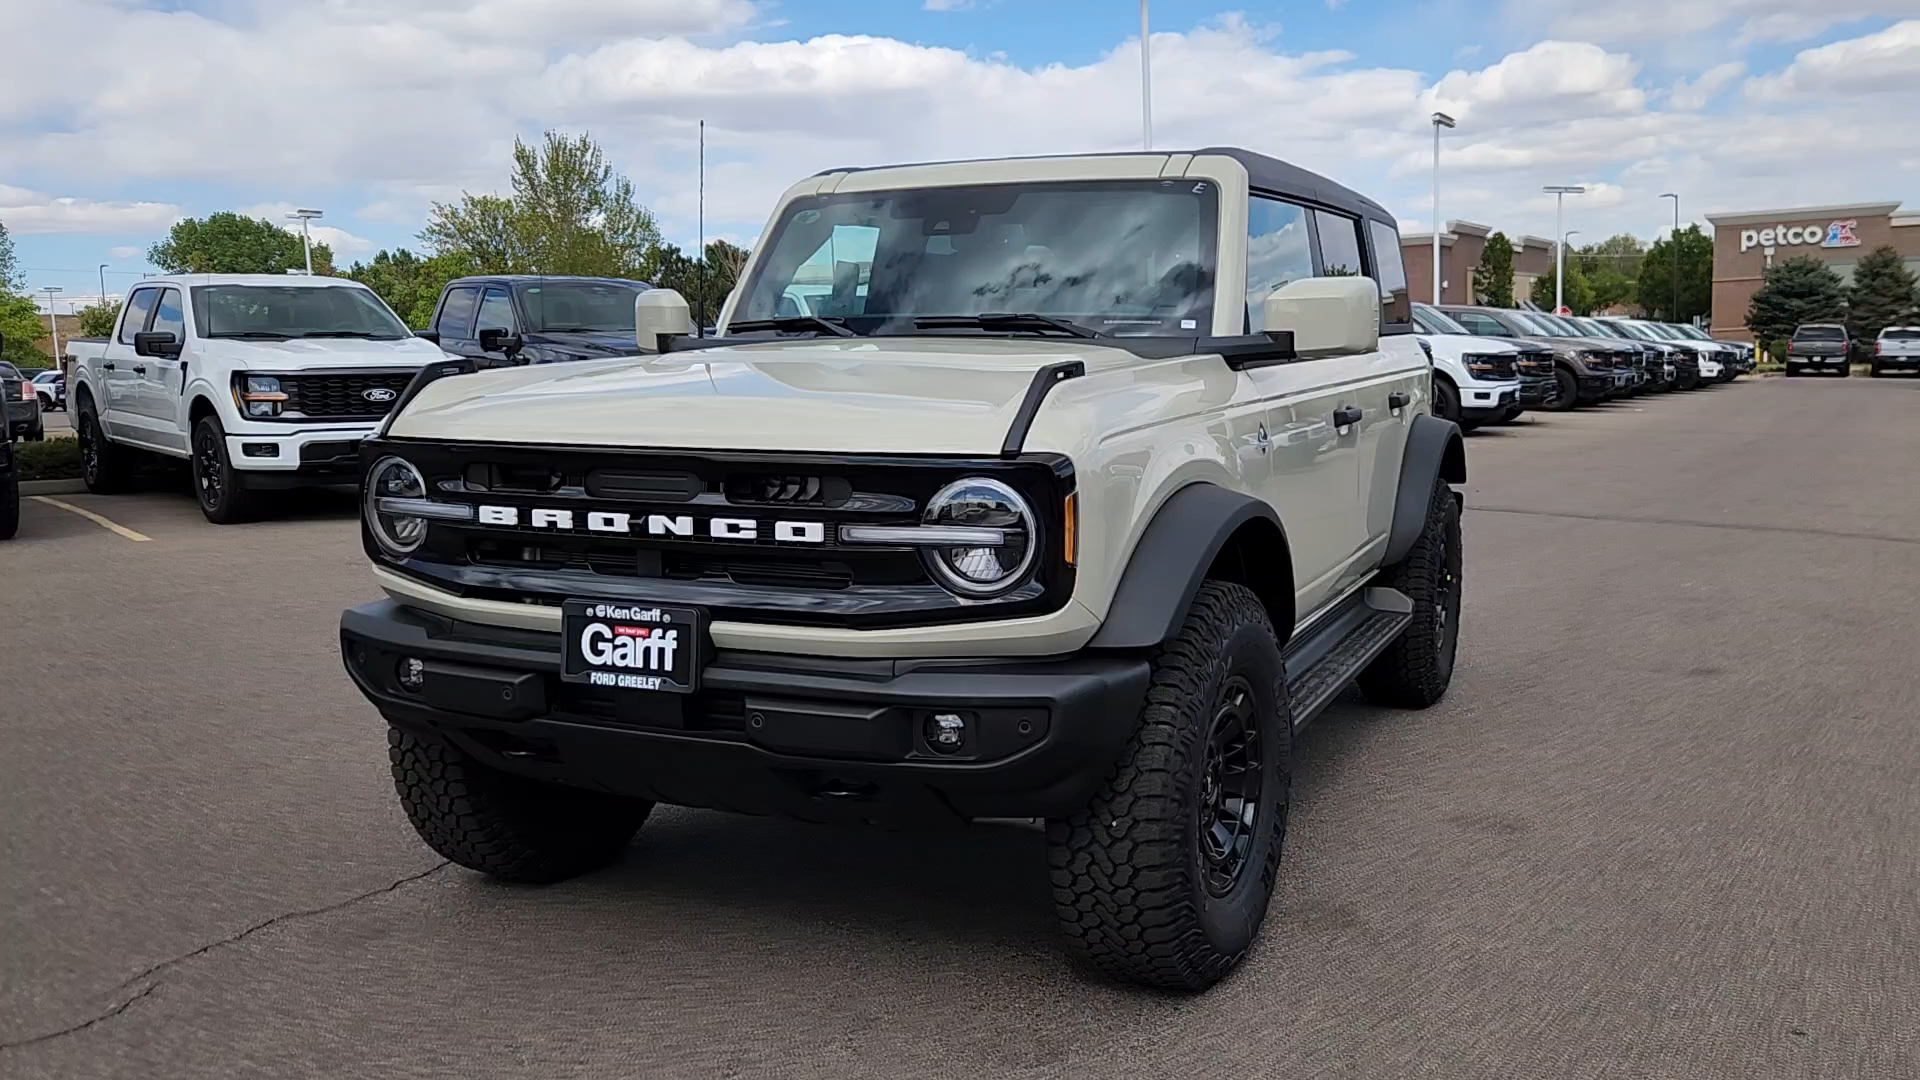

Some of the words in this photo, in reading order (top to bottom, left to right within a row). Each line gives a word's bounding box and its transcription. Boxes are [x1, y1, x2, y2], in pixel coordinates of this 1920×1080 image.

[1740, 224, 1823, 253] petco
[369, 390, 391, 400] Ford
[478, 505, 825, 543] BRONCO
[606, 605, 630, 620] Ken
[630, 607, 661, 622] Garff
[581, 622, 678, 672] Garff
[590, 672, 615, 687] FORD
[617, 674, 661, 690] GREELEY
